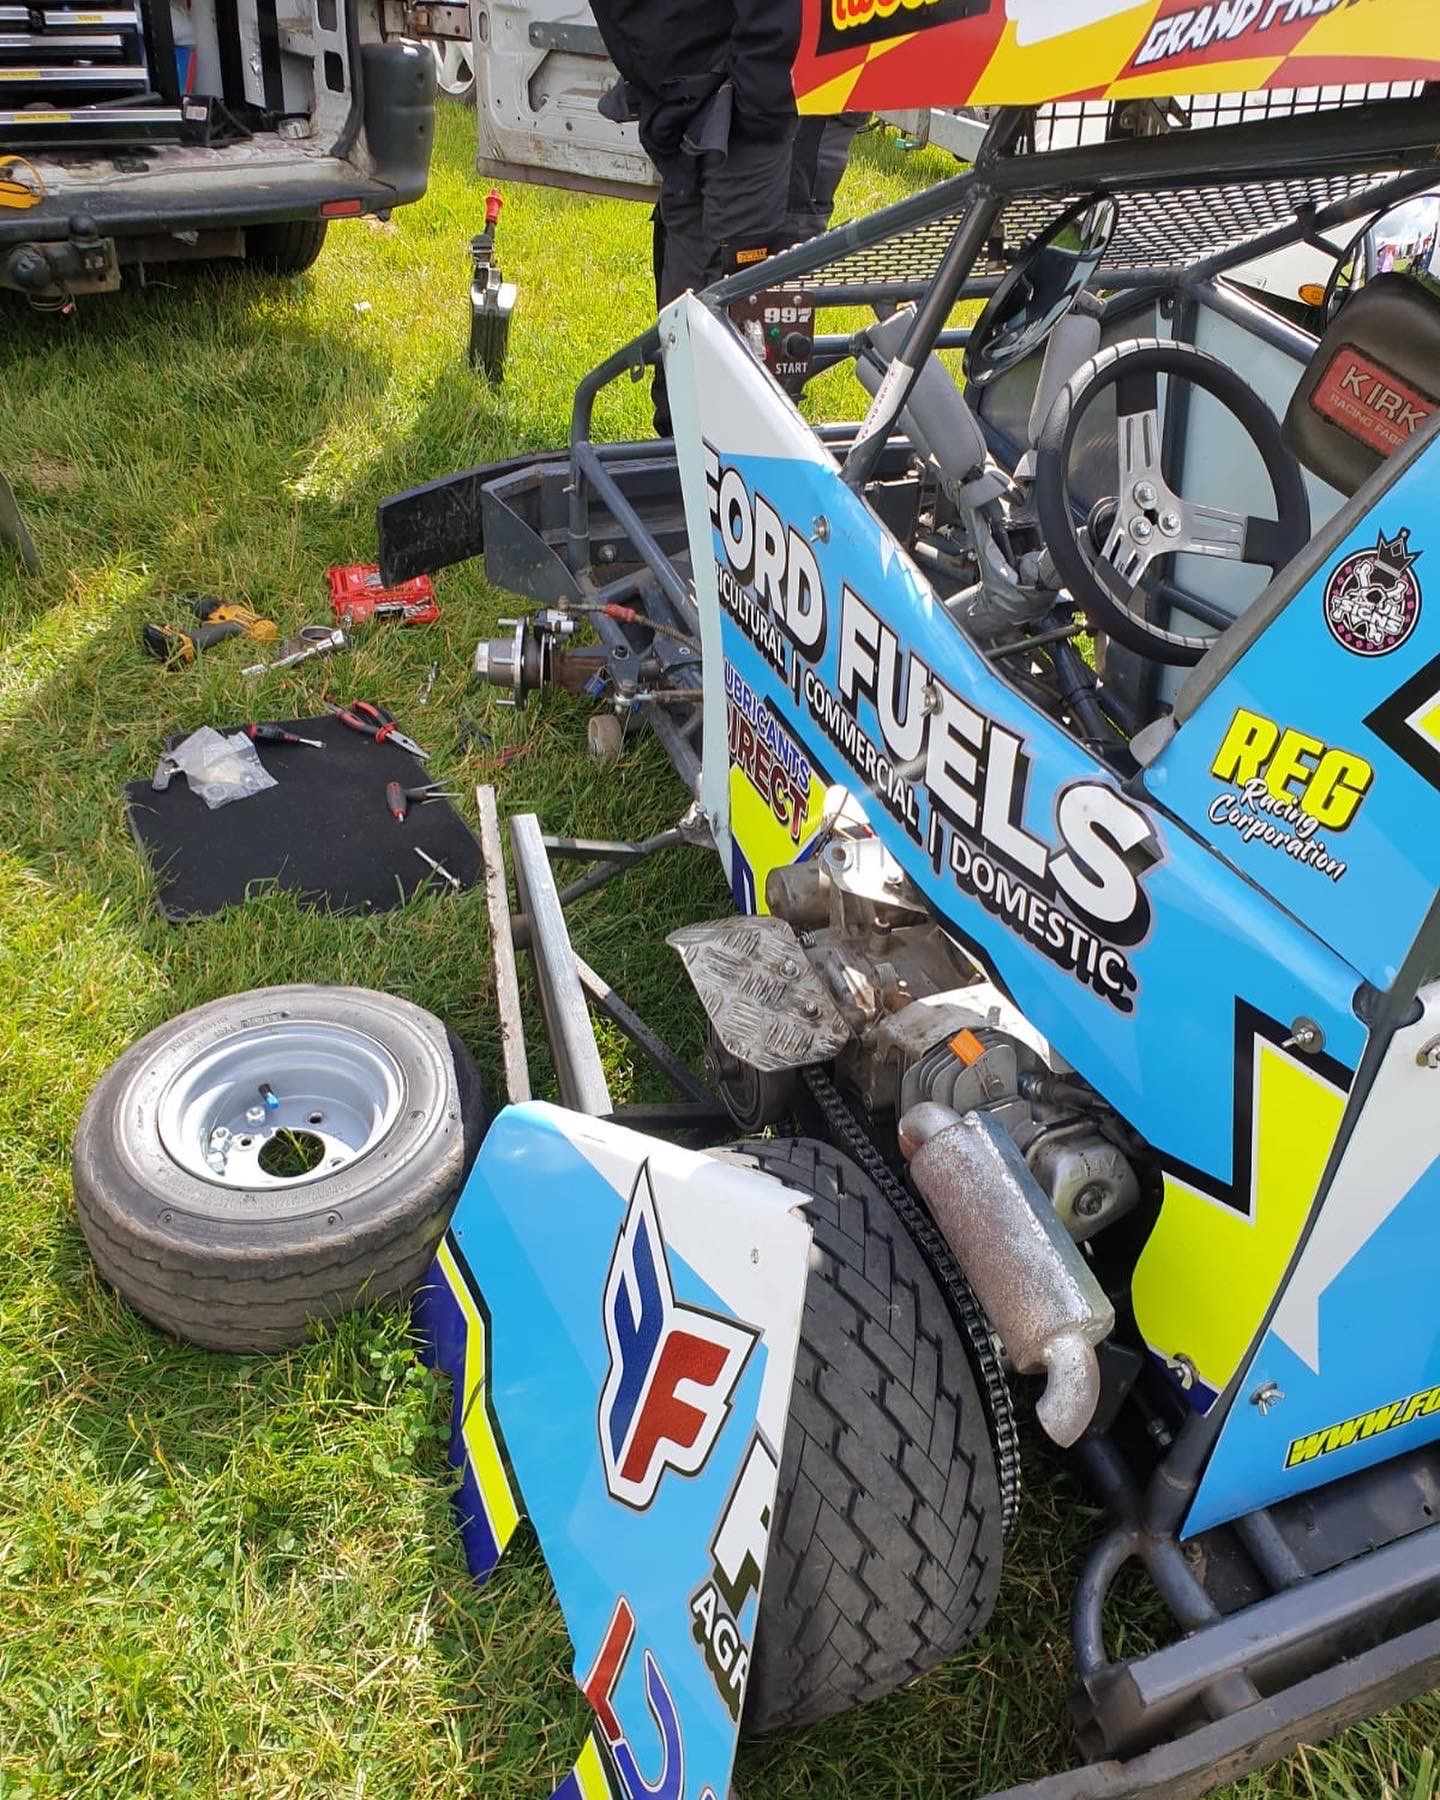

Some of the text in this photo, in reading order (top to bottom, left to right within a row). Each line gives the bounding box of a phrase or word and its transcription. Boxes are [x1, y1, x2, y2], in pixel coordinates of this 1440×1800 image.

[763, 306, 812, 323] 997
[775, 361, 808, 375] START
[1330, 393, 1374, 428] RACING
[1340, 365, 1428, 433] KIRK
[724, 660, 811, 794] UBRICANTS
[727, 702, 809, 840] IRECT
[838, 585, 1156, 932] FUELS
[1211, 707, 1375, 831] REG
[714, 562, 1126, 991] ICULTURAL COMMERCIAL DOMESTIC
[1240, 777, 1322, 839] Racing
[1207, 793, 1348, 883] Corporation
